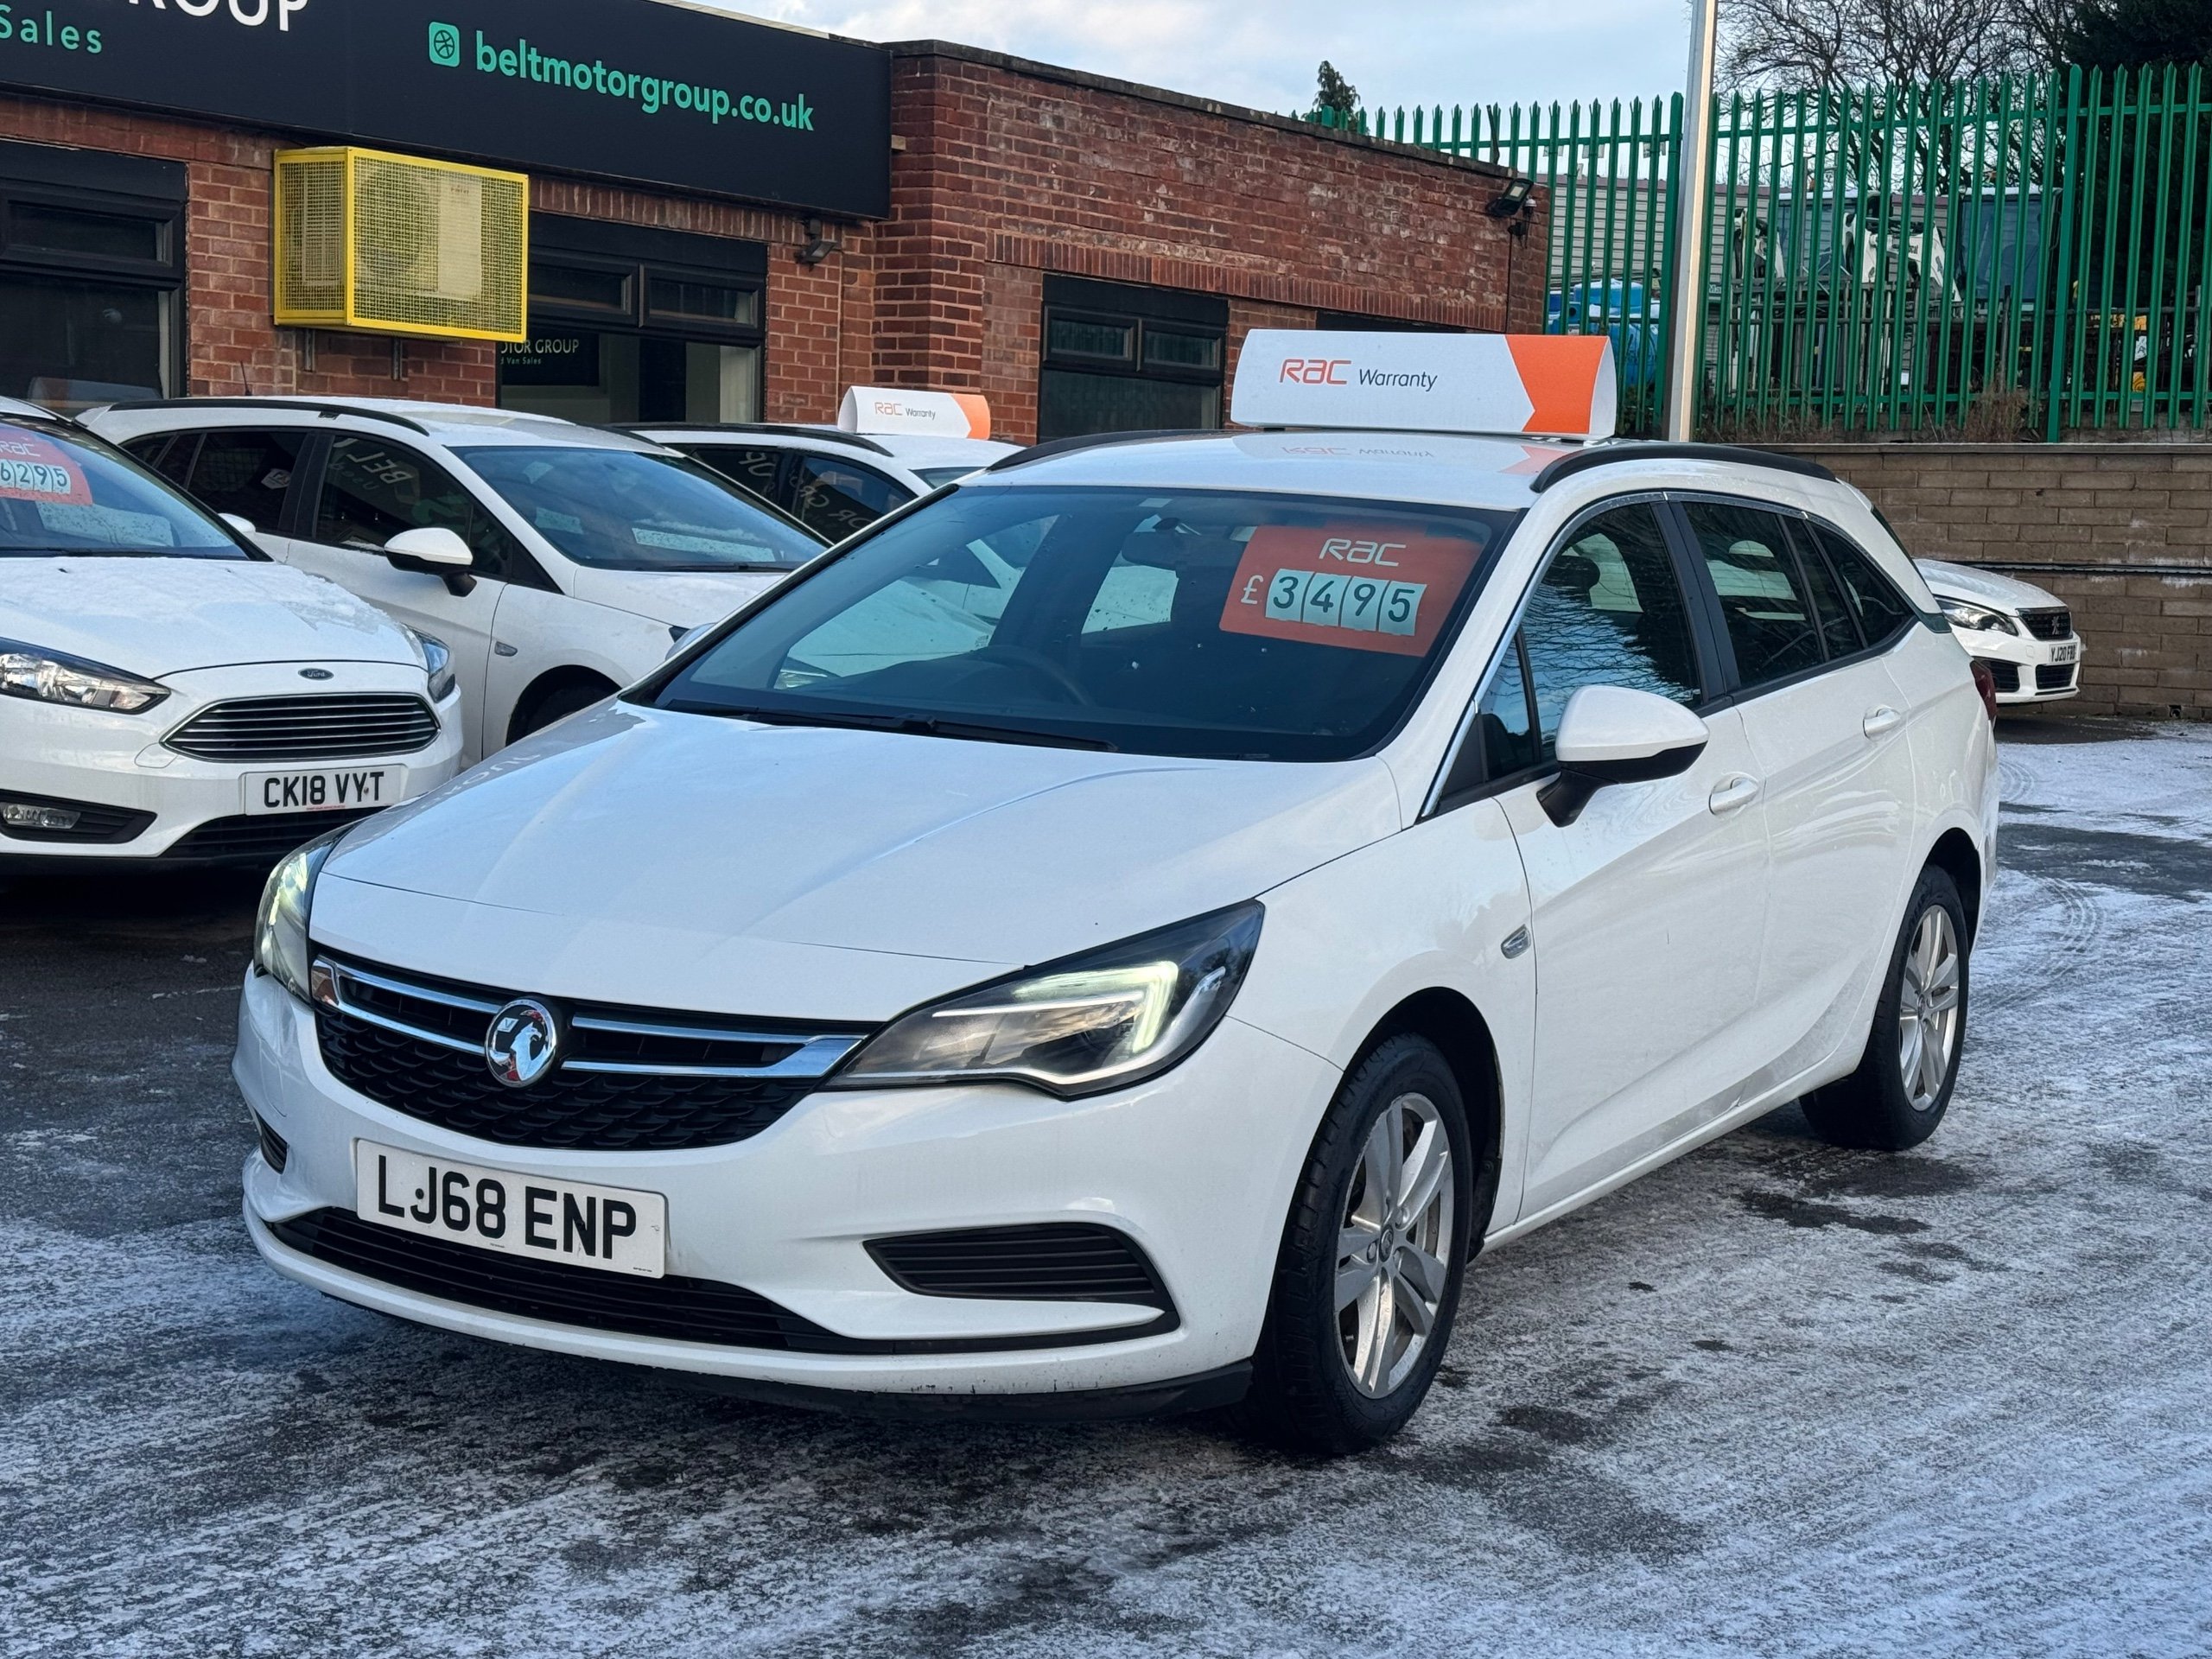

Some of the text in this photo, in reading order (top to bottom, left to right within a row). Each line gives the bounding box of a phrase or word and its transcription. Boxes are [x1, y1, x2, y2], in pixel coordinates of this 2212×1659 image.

[0, 4, 103, 54] Sales
[476, 30, 814, 131] beltmotorgroup.co.uk
[535, 339, 579, 353] GROUP
[1358, 369, 1438, 392] Warranty
[906, 407, 936, 421] Warranty
[264, 772, 385, 808] CK18 VYT
[378, 1154, 636, 1260] LJ68 ENP
